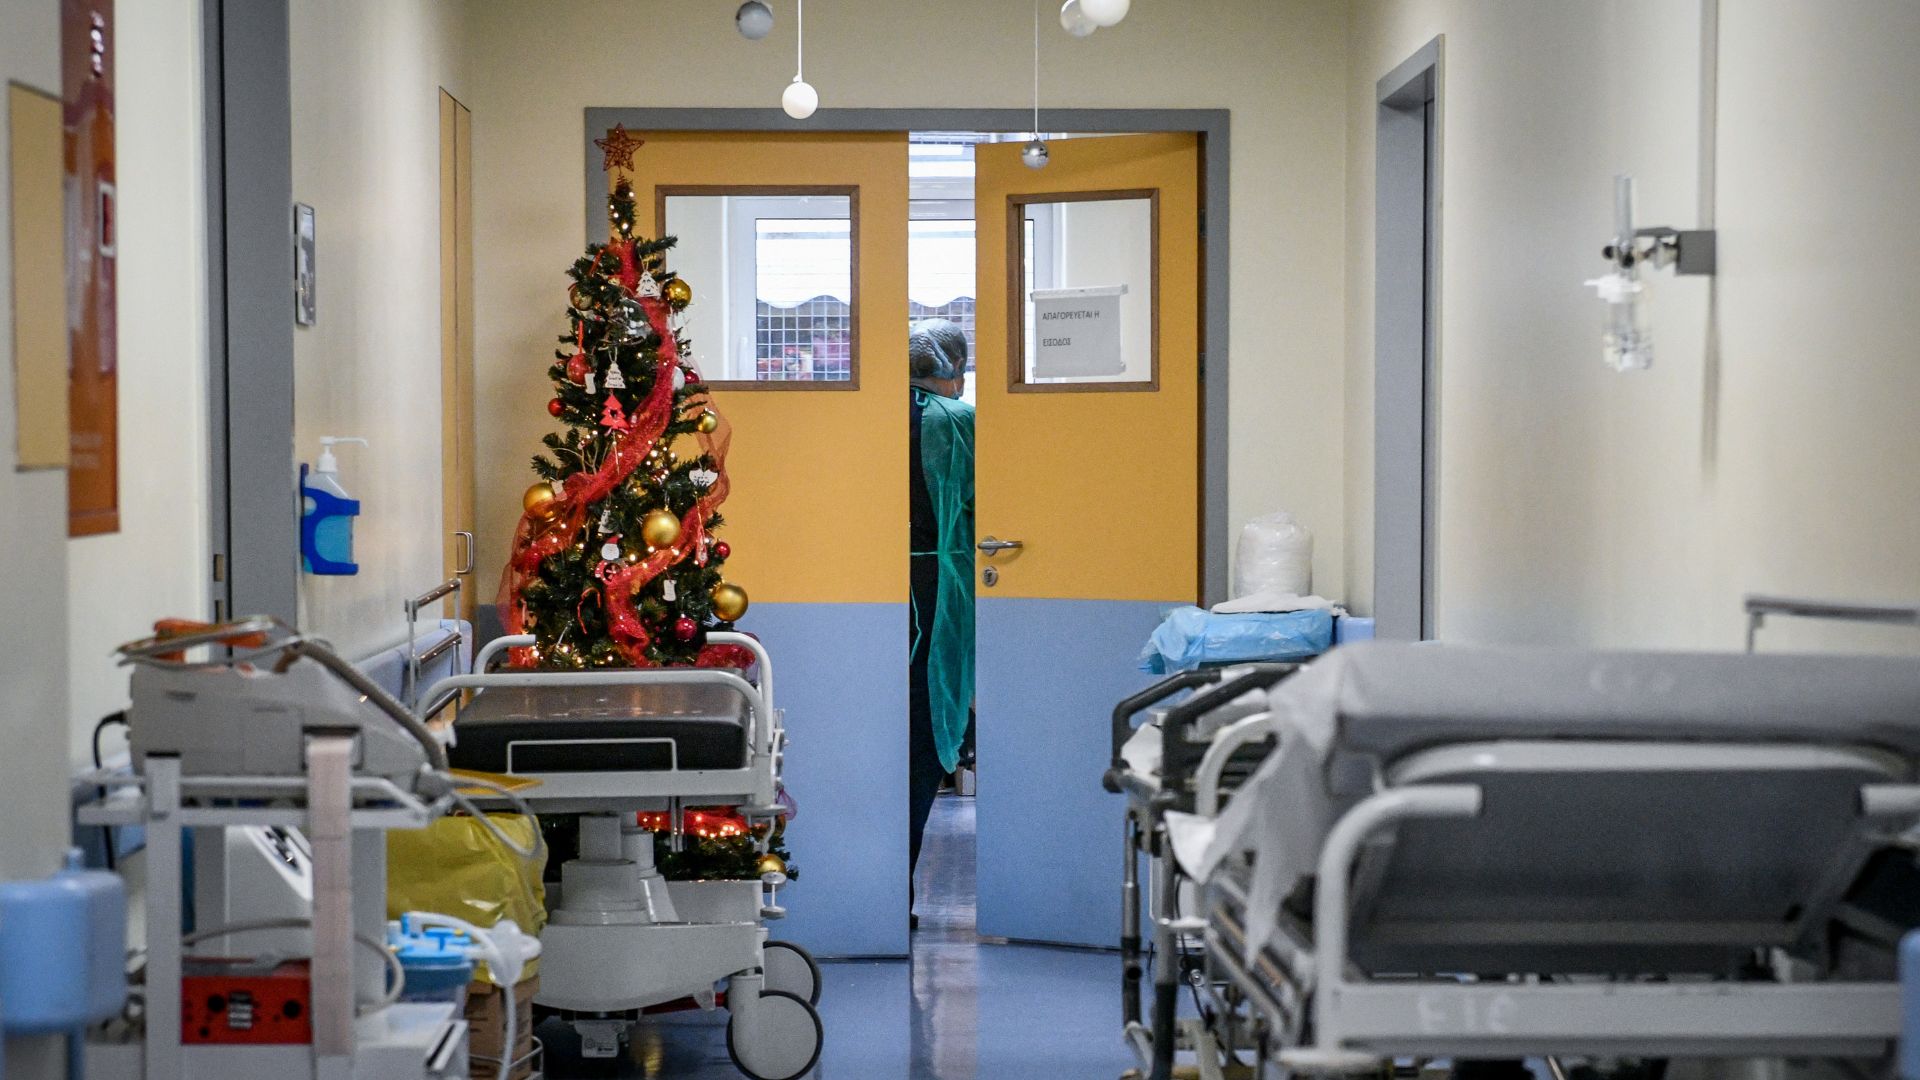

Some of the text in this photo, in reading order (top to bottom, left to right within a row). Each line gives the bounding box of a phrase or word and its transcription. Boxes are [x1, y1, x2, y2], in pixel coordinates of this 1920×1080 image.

[1042, 310, 1100, 320] ΑΠΑΓΟΡΕΥΕΤΑΙ Η
[1042, 337, 1071, 347] ΕΙΣΟΔΟΣ
